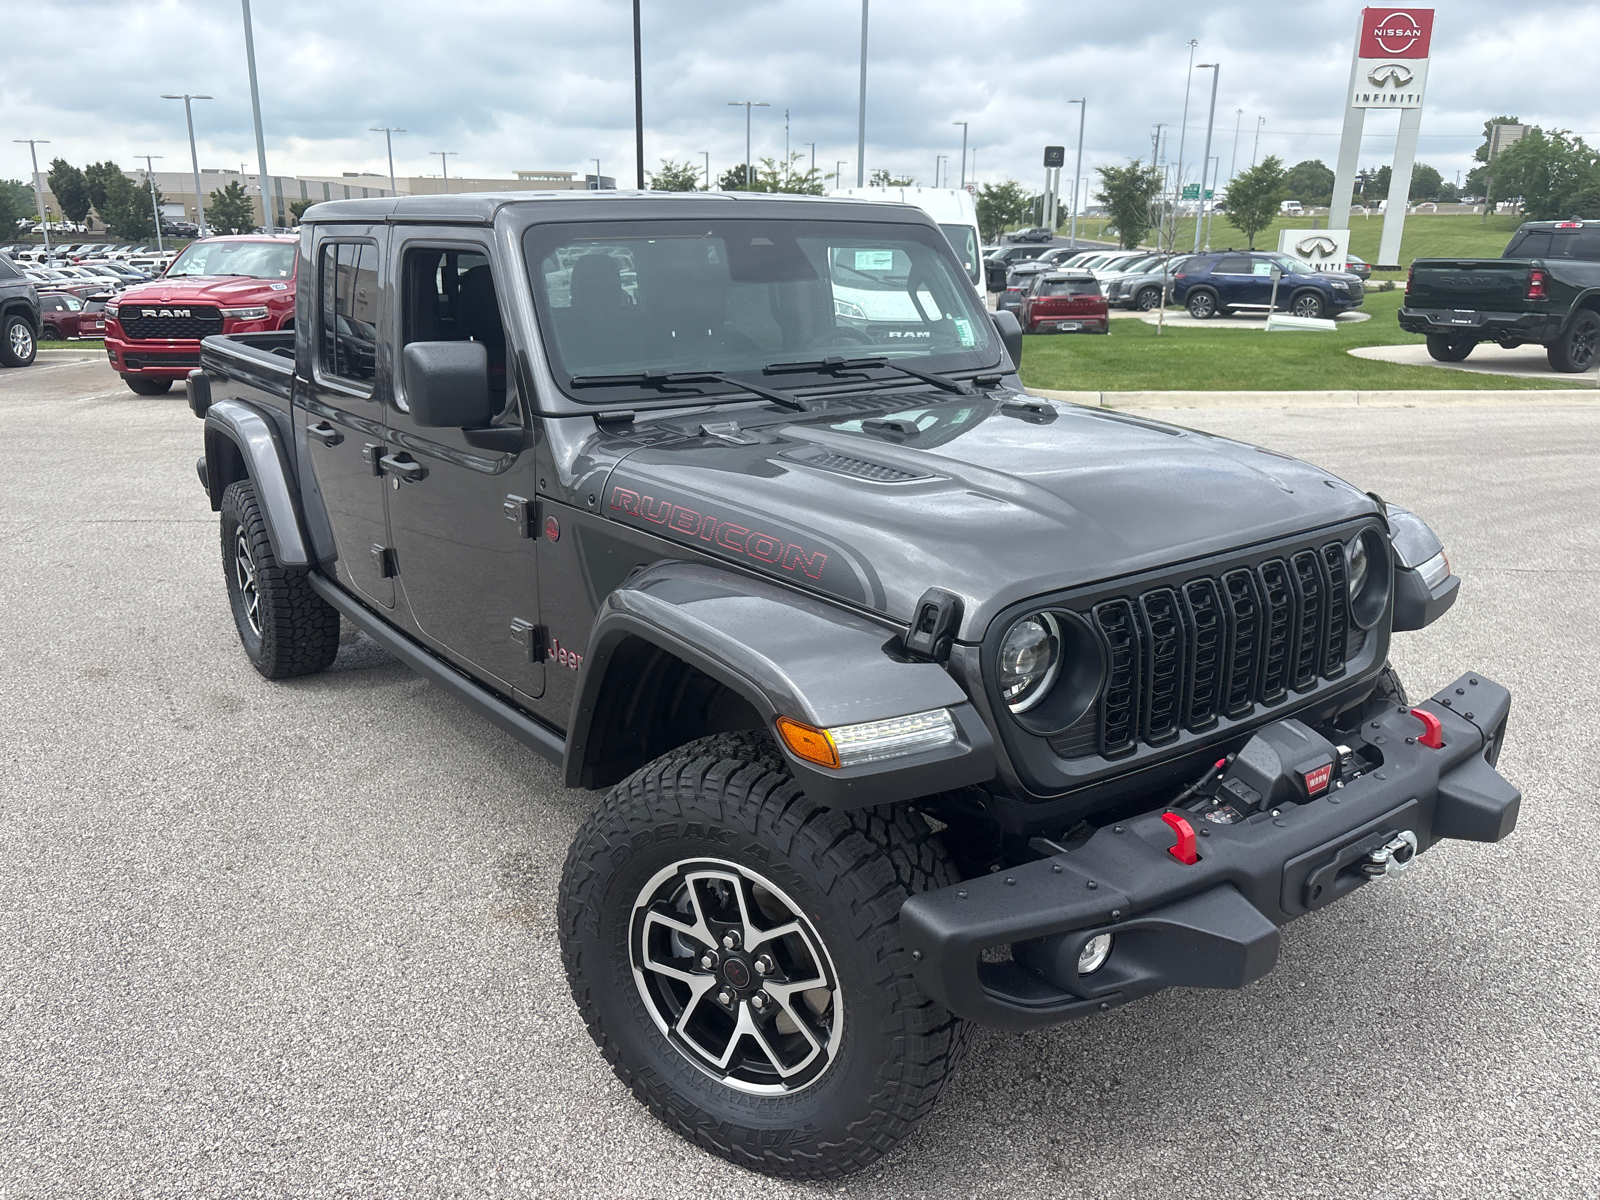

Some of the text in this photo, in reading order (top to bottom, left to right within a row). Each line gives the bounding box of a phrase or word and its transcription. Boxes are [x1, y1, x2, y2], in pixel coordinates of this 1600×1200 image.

[1374, 29, 1421, 37] NISSAN
[1355, 93, 1421, 103] INFINITI
[1309, 263, 1342, 272] INITI
[141, 309, 192, 318] RAM
[610, 486, 828, 580] RUBICON
[1309, 772, 1328, 788] WARN
